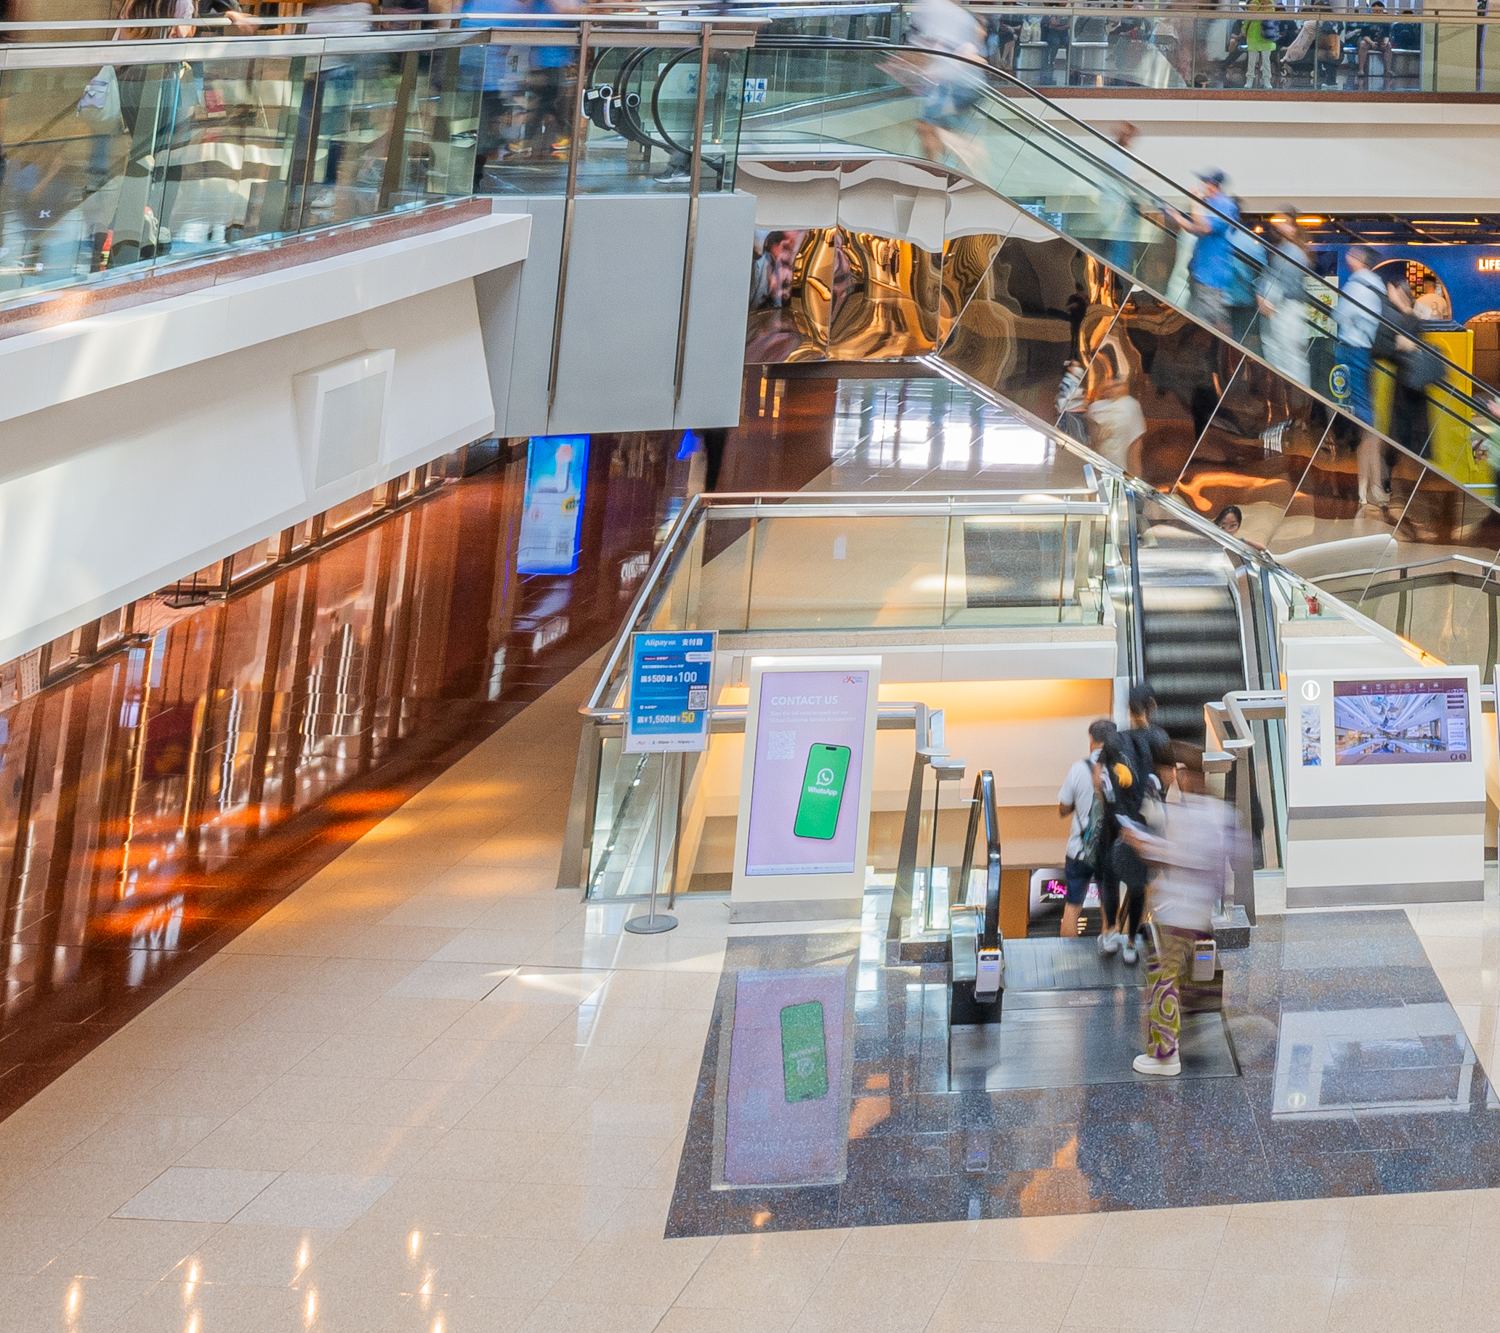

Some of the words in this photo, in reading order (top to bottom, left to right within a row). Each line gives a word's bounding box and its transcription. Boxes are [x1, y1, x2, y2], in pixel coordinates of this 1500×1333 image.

[771, 695, 823, 706] CONTACT
[824, 695, 839, 705] US
[807, 785, 838, 796] WhatsApp
